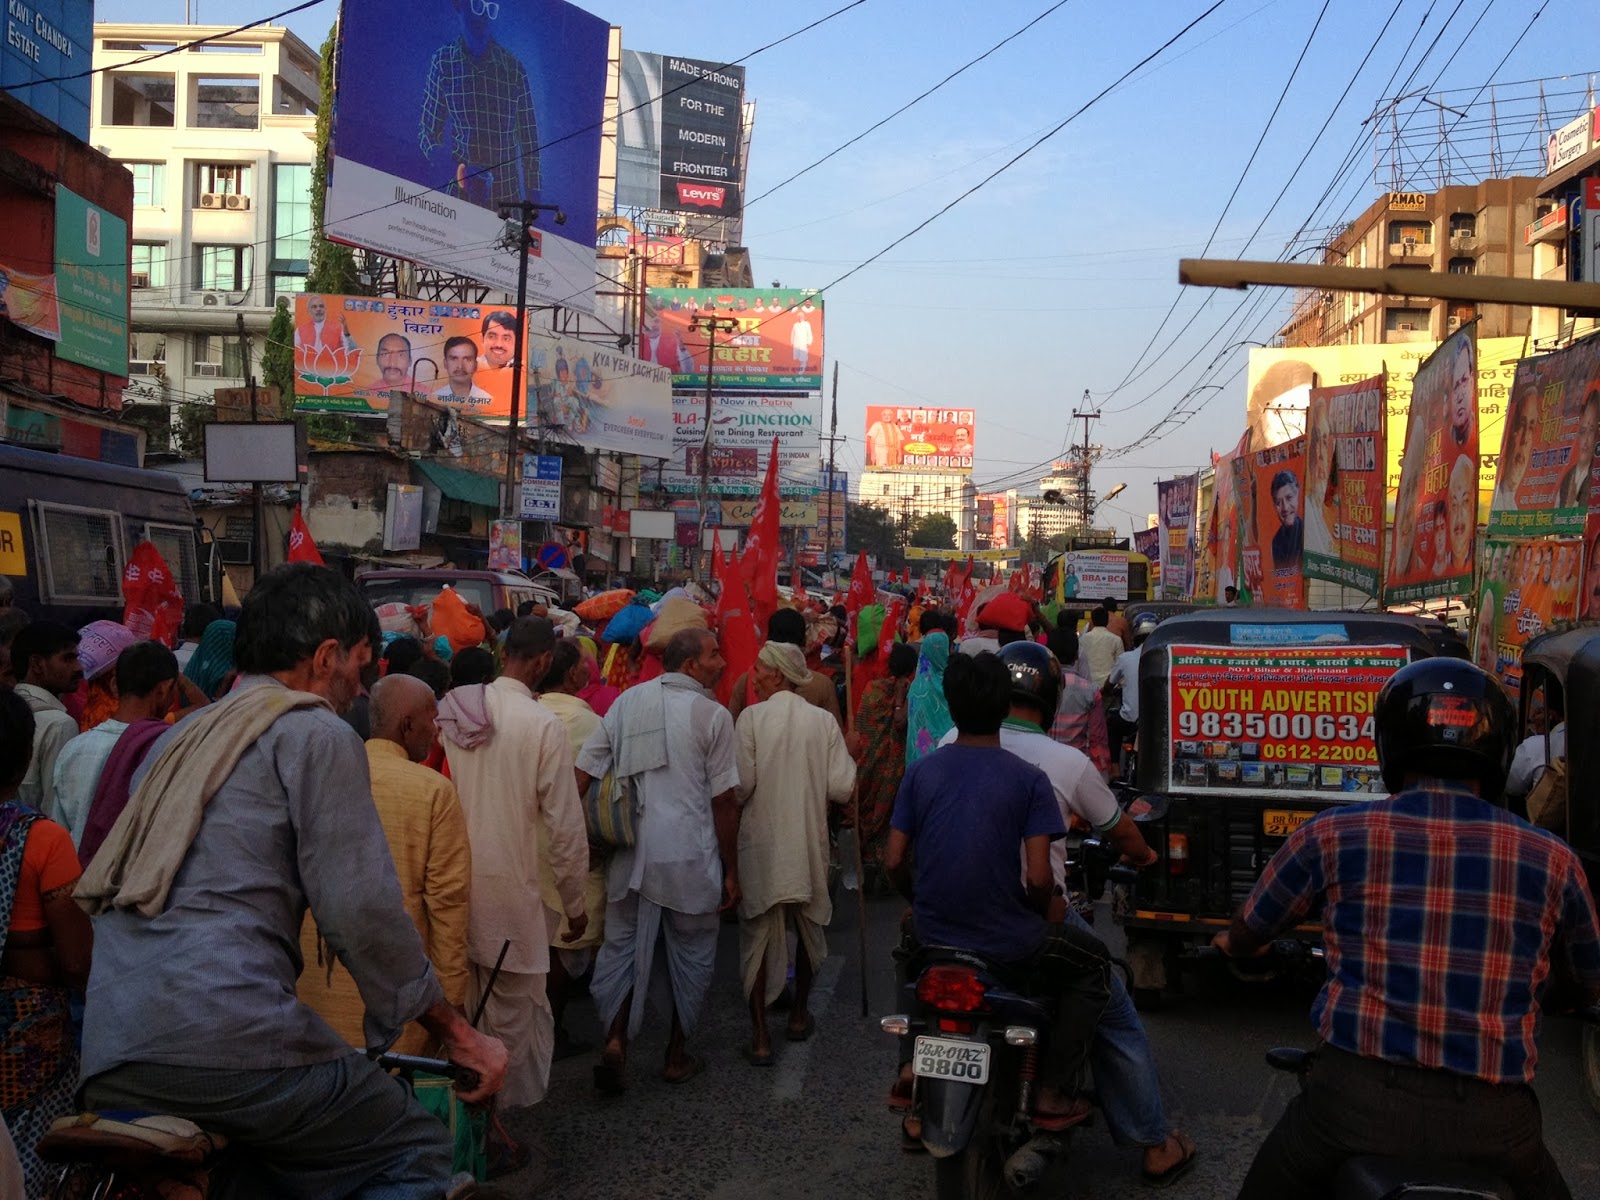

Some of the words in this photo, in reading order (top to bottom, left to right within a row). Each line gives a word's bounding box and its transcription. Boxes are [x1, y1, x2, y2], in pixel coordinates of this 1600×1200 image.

[8, 20, 40, 63] ESTATE
[35, 12, 73, 59] CHANDRA
[669, 58, 700, 77] MADE
[701, 69, 739, 89] STRONG
[680, 97, 702, 112] FOR
[705, 102, 725, 117] THE
[678, 129, 726, 147] MODERN
[1558, 120, 1588, 146] Cosmetic
[1557, 141, 1583, 162] Surgery
[673, 161, 728, 177] FRONTIER
[394, 185, 457, 220] Illumination
[1391, 193, 1425, 205] AMAC
[387, 303, 425, 321] हुंकार
[403, 319, 445, 337] बिहार
[592, 351, 610, 368] KYA
[612, 357, 630, 372] YEH
[631, 363, 651, 377] SACH
[467, 394, 492, 408] कुमार
[690, 397, 717, 405] Dehi
[761, 398, 793, 406] Patna
[737, 414, 812, 427] JUNCTION
[676, 427, 705, 435] Cuisine
[728, 428, 755, 438] Dining
[758, 428, 804, 438] Restaurant
[522, 479, 560, 487] COMMERCE
[723, 485, 745, 494] Mob.
[1082, 574, 1101, 582] BBA
[1107, 575, 1127, 583] BCA
[1264, 657, 1275, 665] में
[1353, 657, 1365, 666] में
[1369, 658, 1401, 667] कमाई
[1178, 688, 1254, 711] YOUTH
[1178, 711, 1376, 741] 983500634
[1263, 743, 1379, 762] 0612-22004
[1273, 815, 1286, 824] BR
[920, 1057, 982, 1079] 9800
